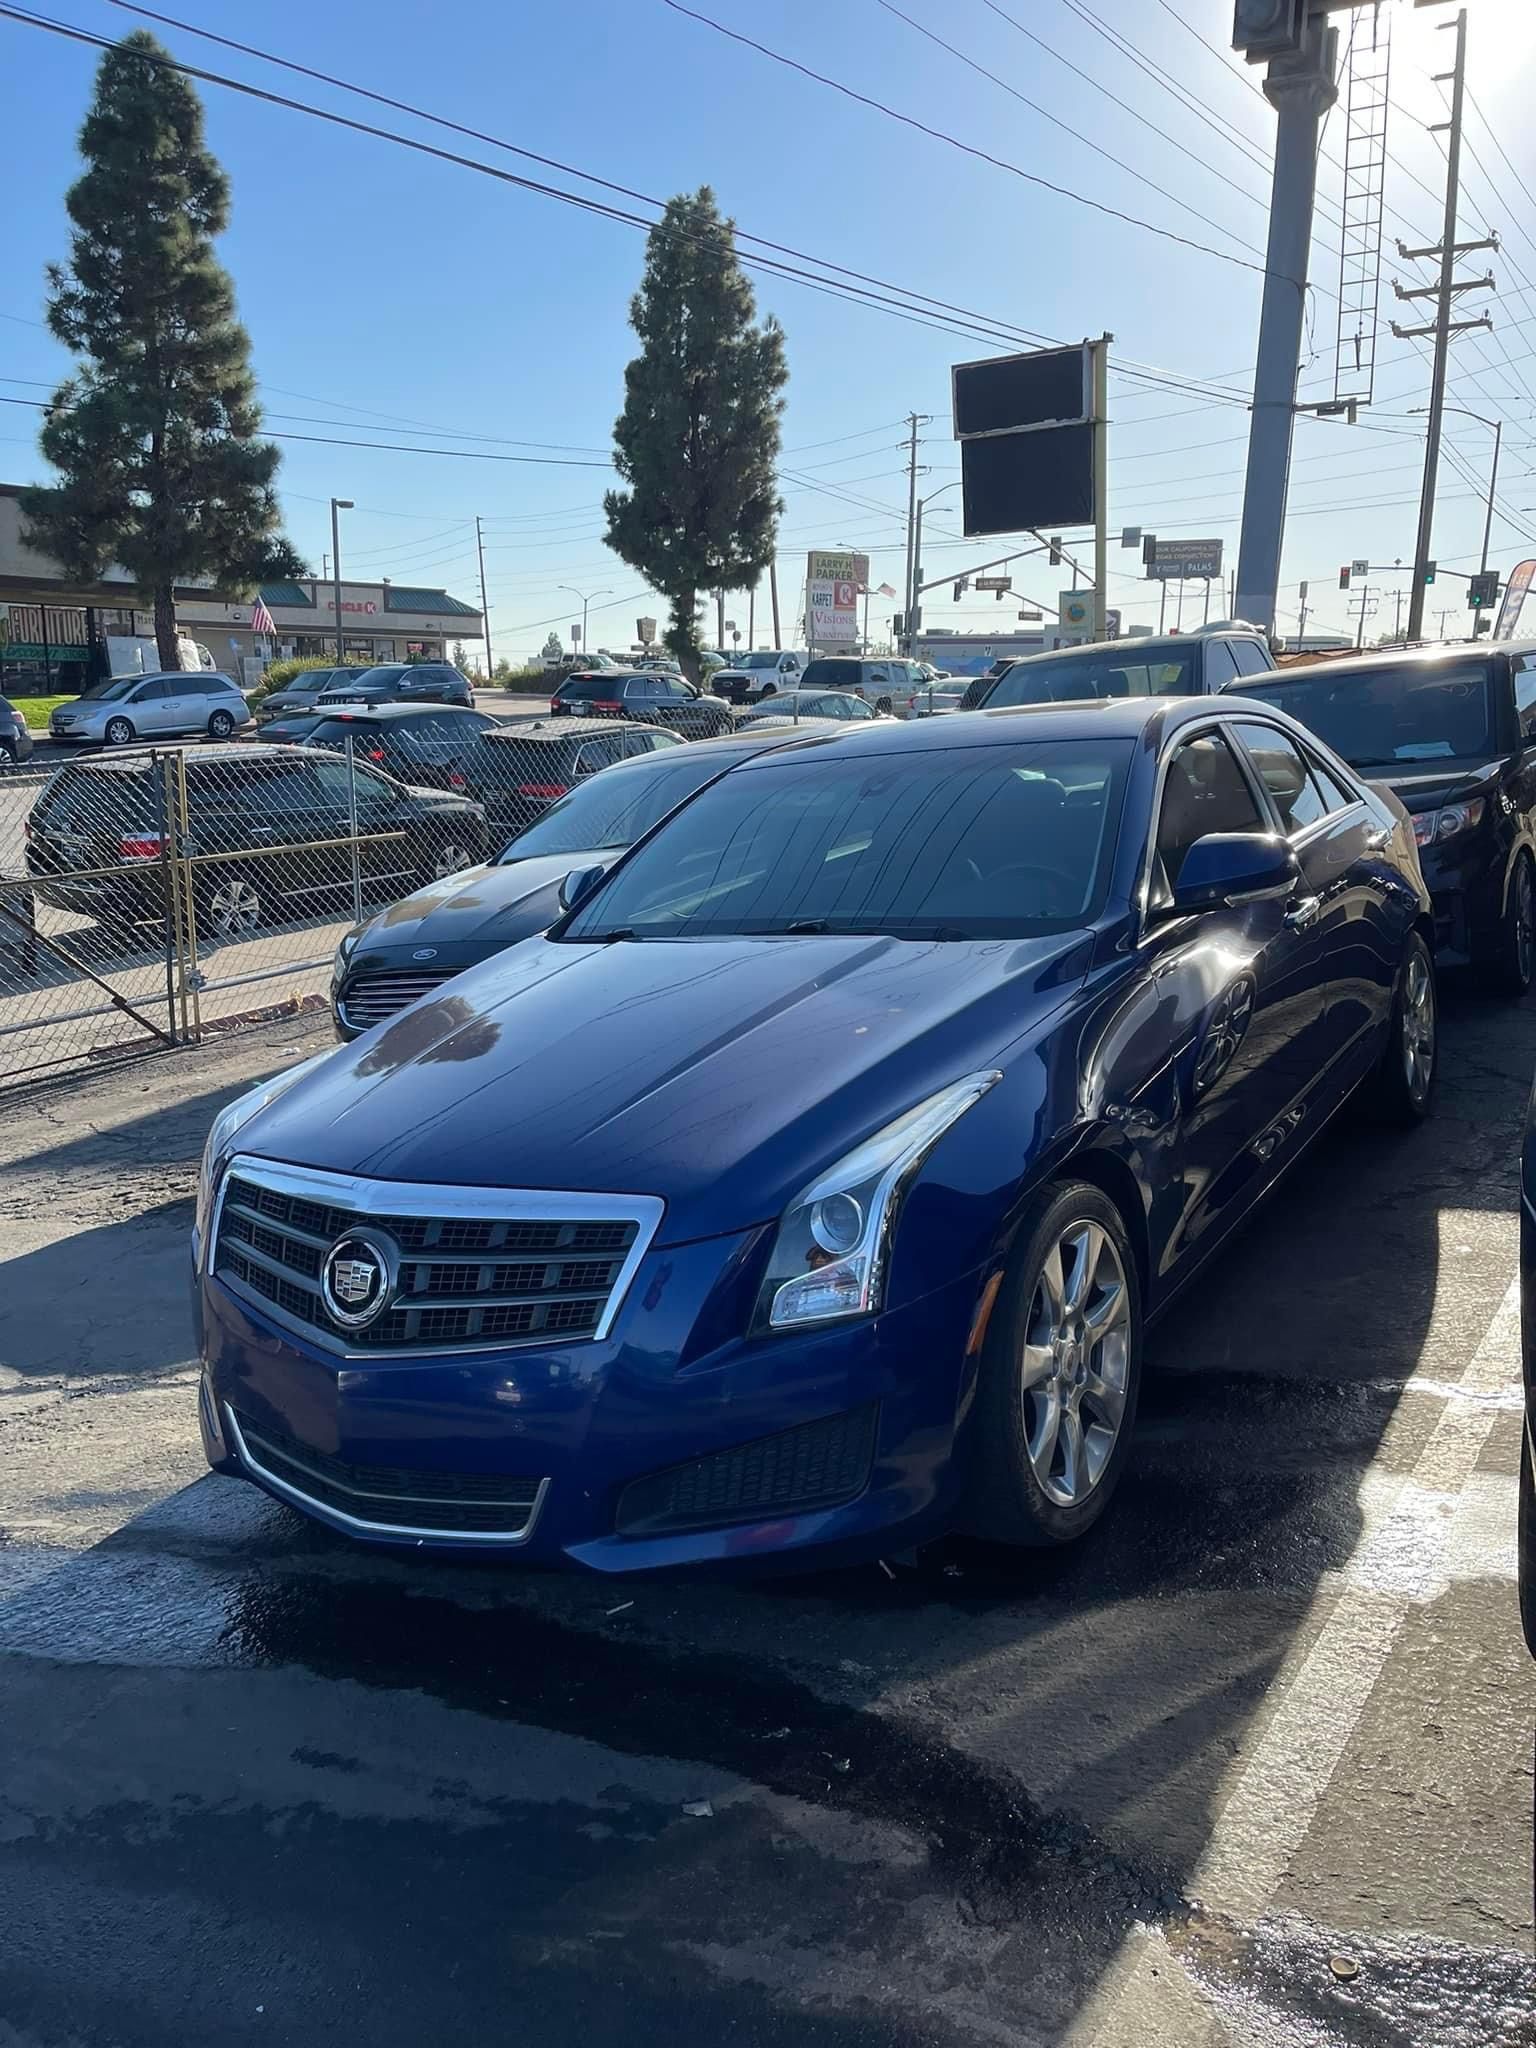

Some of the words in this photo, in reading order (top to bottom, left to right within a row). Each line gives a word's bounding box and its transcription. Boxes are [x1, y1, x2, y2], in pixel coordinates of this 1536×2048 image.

[816, 559, 842, 569] LARRY
[1187, 562, 1212, 572] PALMS
[816, 569, 853, 580] PARKER
[328, 601, 362, 612] CRCLE
